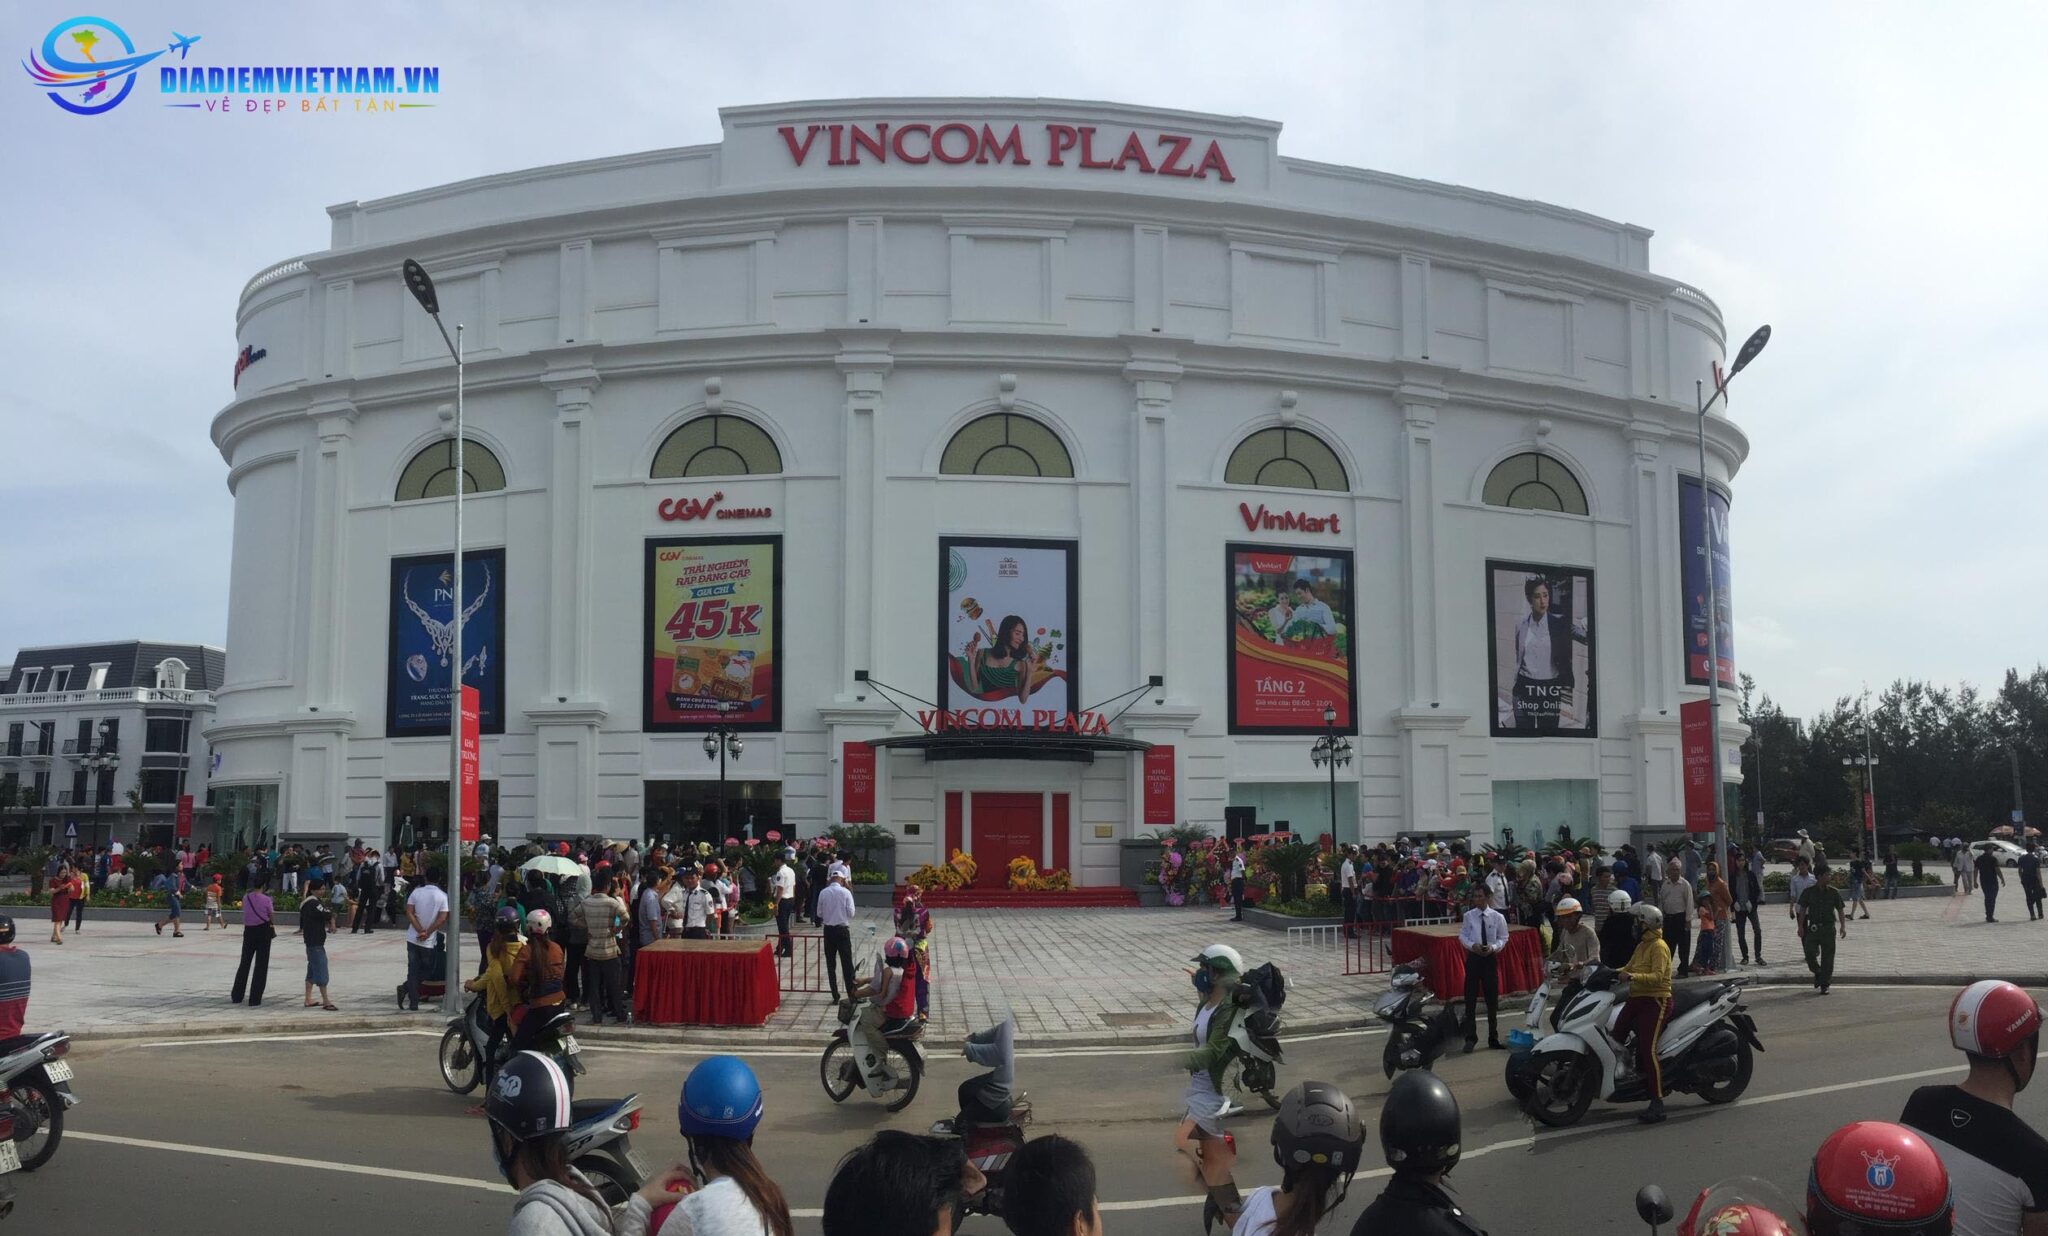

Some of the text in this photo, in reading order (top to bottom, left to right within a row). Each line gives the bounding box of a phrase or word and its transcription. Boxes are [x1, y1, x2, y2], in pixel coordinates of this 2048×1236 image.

[778, 123, 1236, 182] VINCOM PLAZA
[658, 497, 772, 521] CGV CINEMAS
[1240, 503, 1341, 533] VinMart
[660, 552, 681, 561] CGV
[434, 587, 454, 602] PN
[664, 599, 762, 642] 45K
[1255, 676, 1305, 693] TẦNG 2
[1525, 685, 1560, 696] TNG
[1517, 700, 1539, 711] Shop
[917, 708, 1110, 735] VINCOM PLAZA
[2006, 1009, 2032, 1033] YAMAHA
